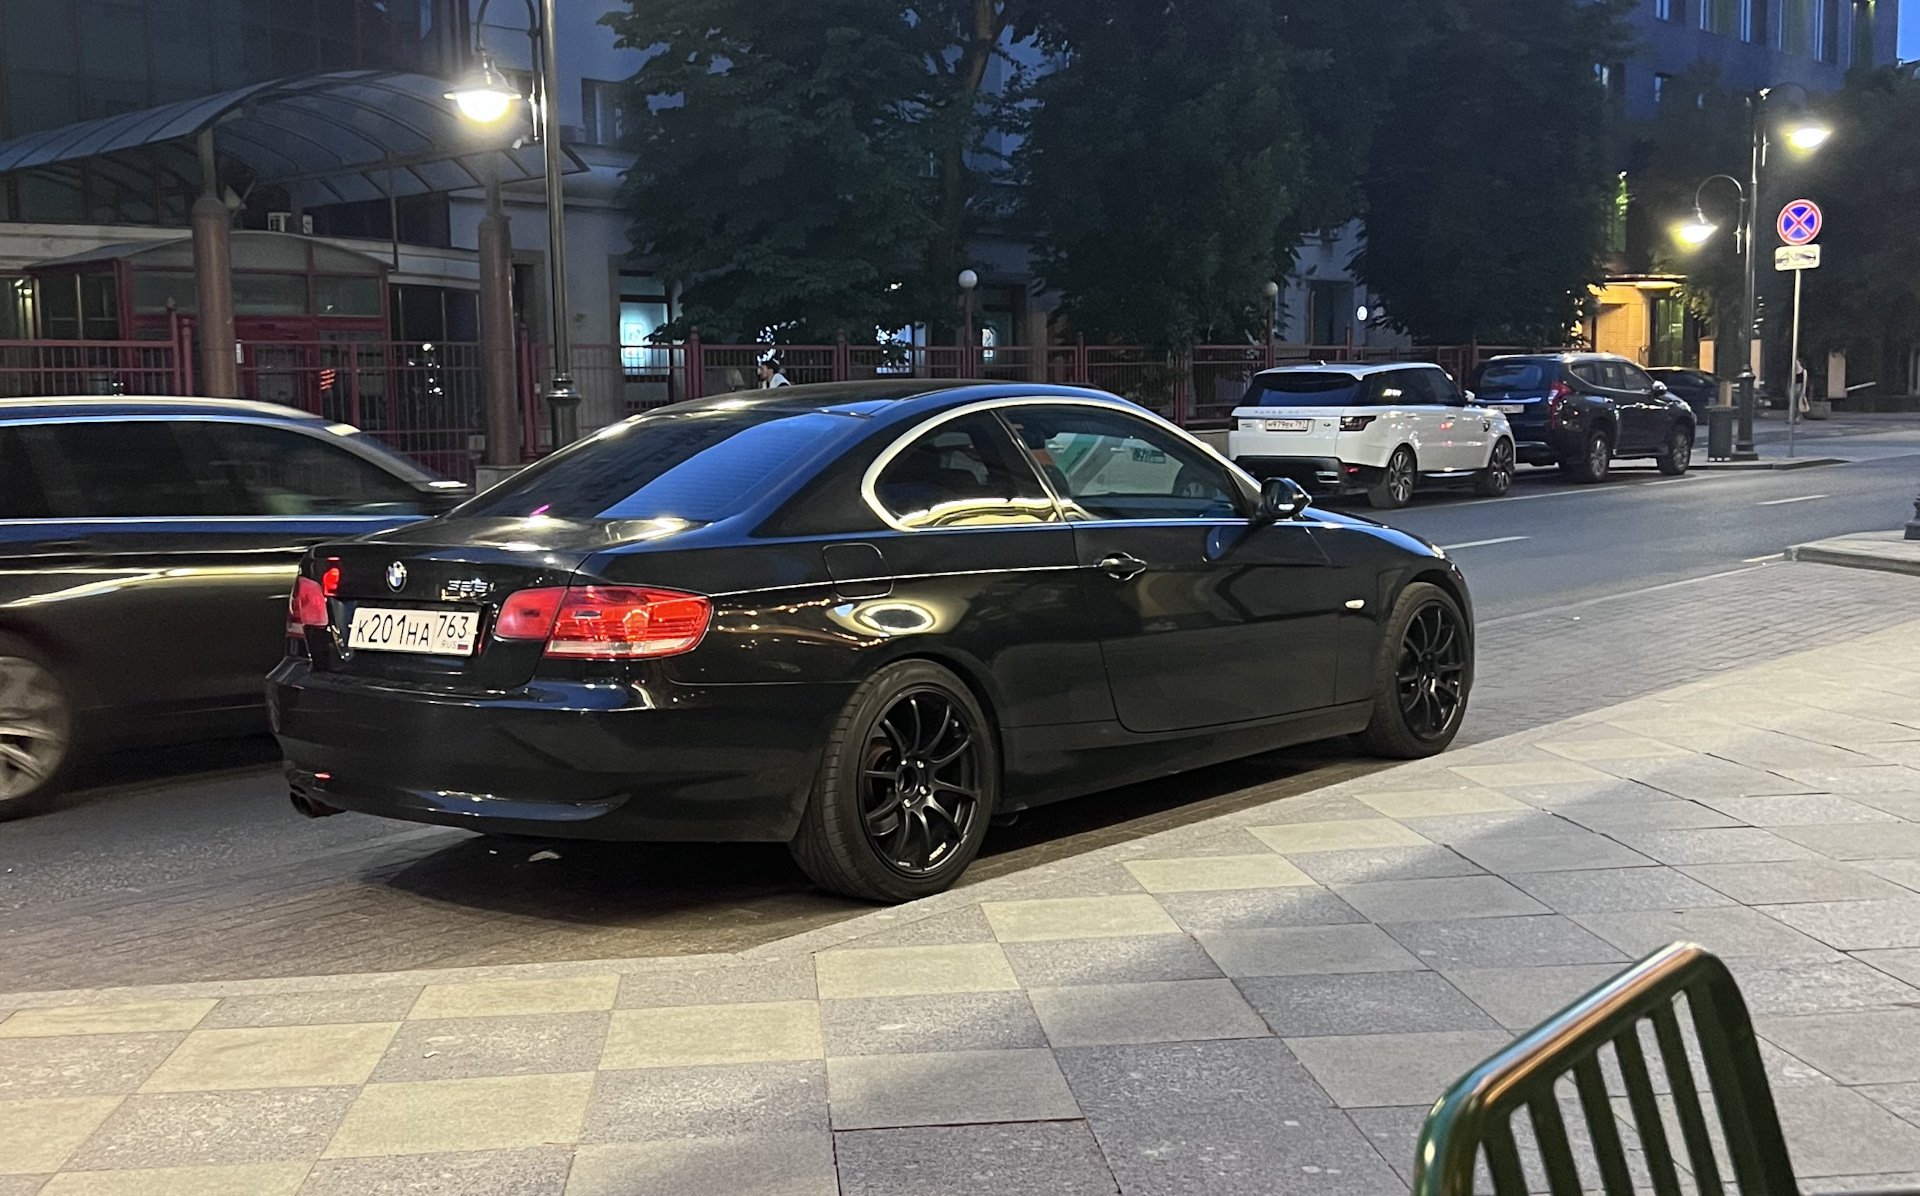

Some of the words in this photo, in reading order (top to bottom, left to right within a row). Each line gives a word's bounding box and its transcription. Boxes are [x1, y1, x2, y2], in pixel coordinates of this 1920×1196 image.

[356, 613, 430, 646] К201НА
[437, 614, 469, 639] 763
[441, 639, 458, 650] RUS
